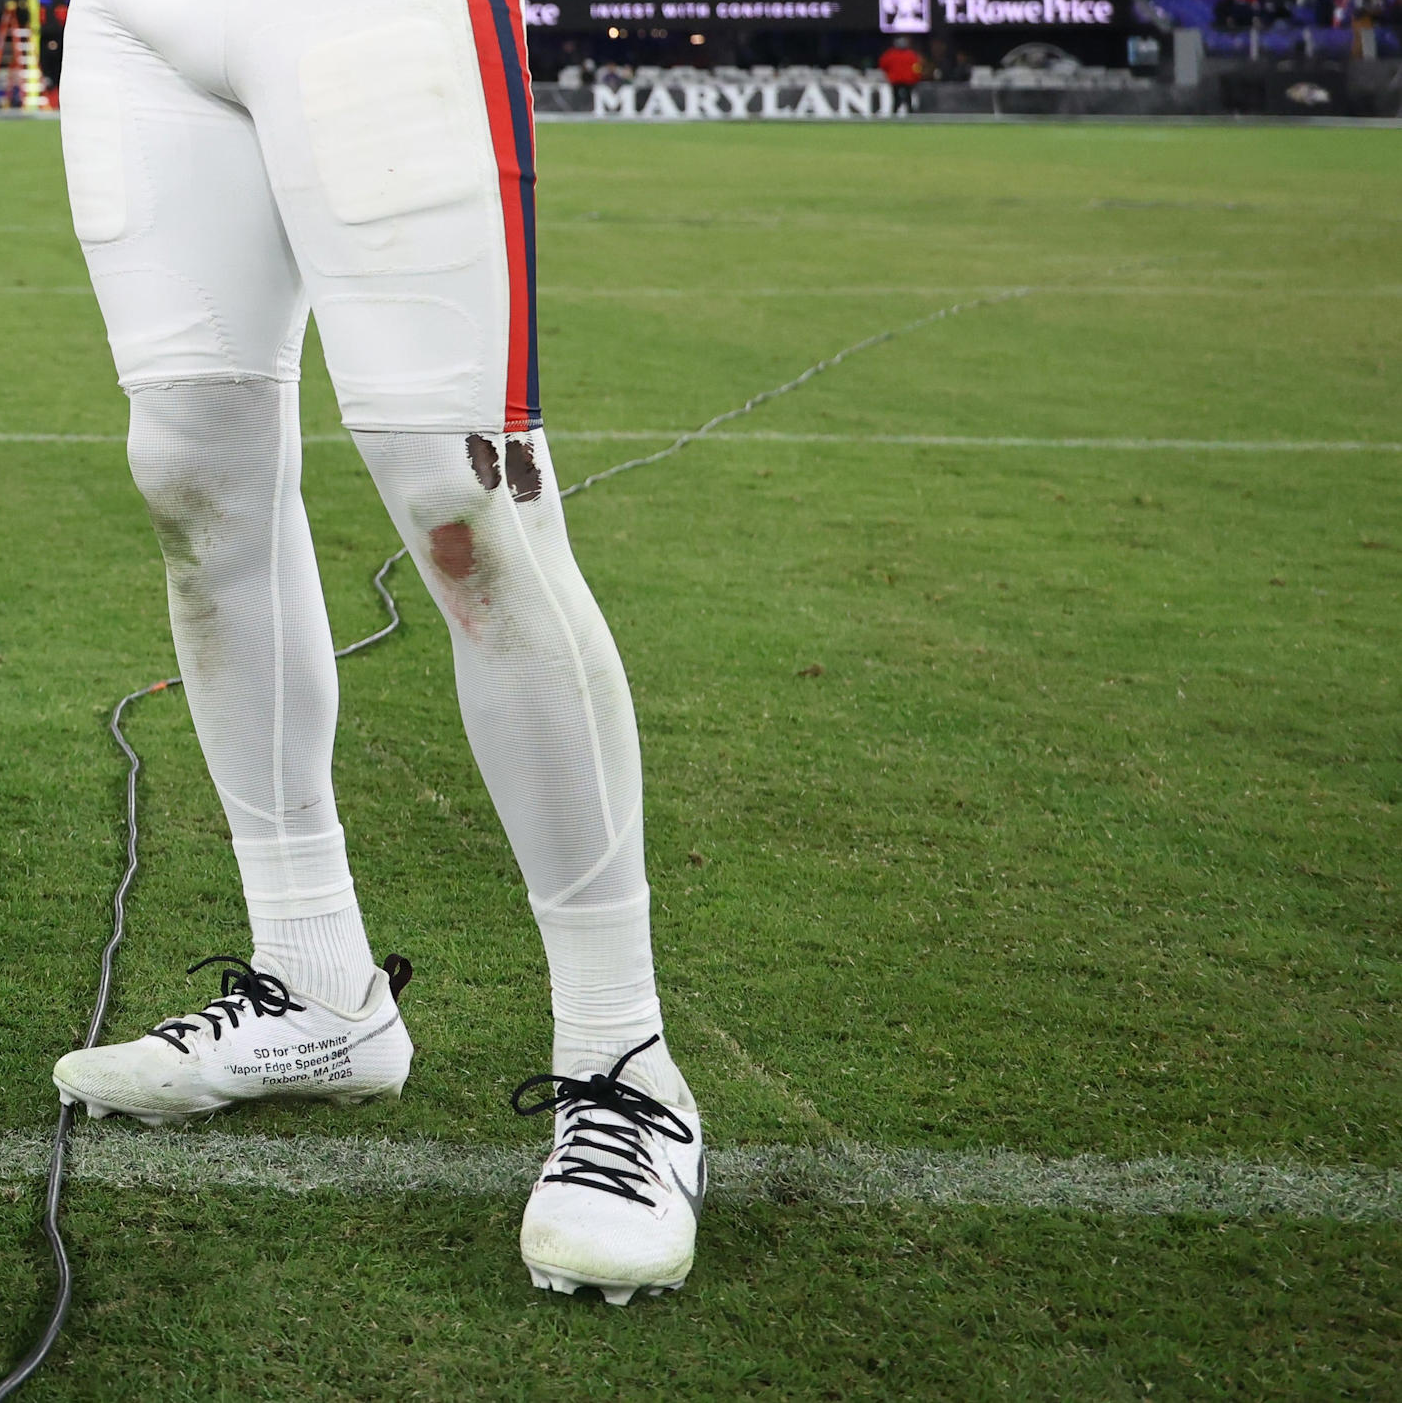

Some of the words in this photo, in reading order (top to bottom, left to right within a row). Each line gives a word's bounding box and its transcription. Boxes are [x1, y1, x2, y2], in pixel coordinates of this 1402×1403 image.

[590, 2, 655, 20] INVEST
[661, 2, 711, 20] WITH
[716, 2, 833, 20] CONFIDENCE
[253, 1048, 270, 1059] SD
[272, 1047, 289, 1058] for
[265, 1062, 292, 1073] Edge
[295, 1054, 329, 1070] Speed
[313, 1066, 329, 1078] MA
[328, 1068, 353, 1082] 2025
